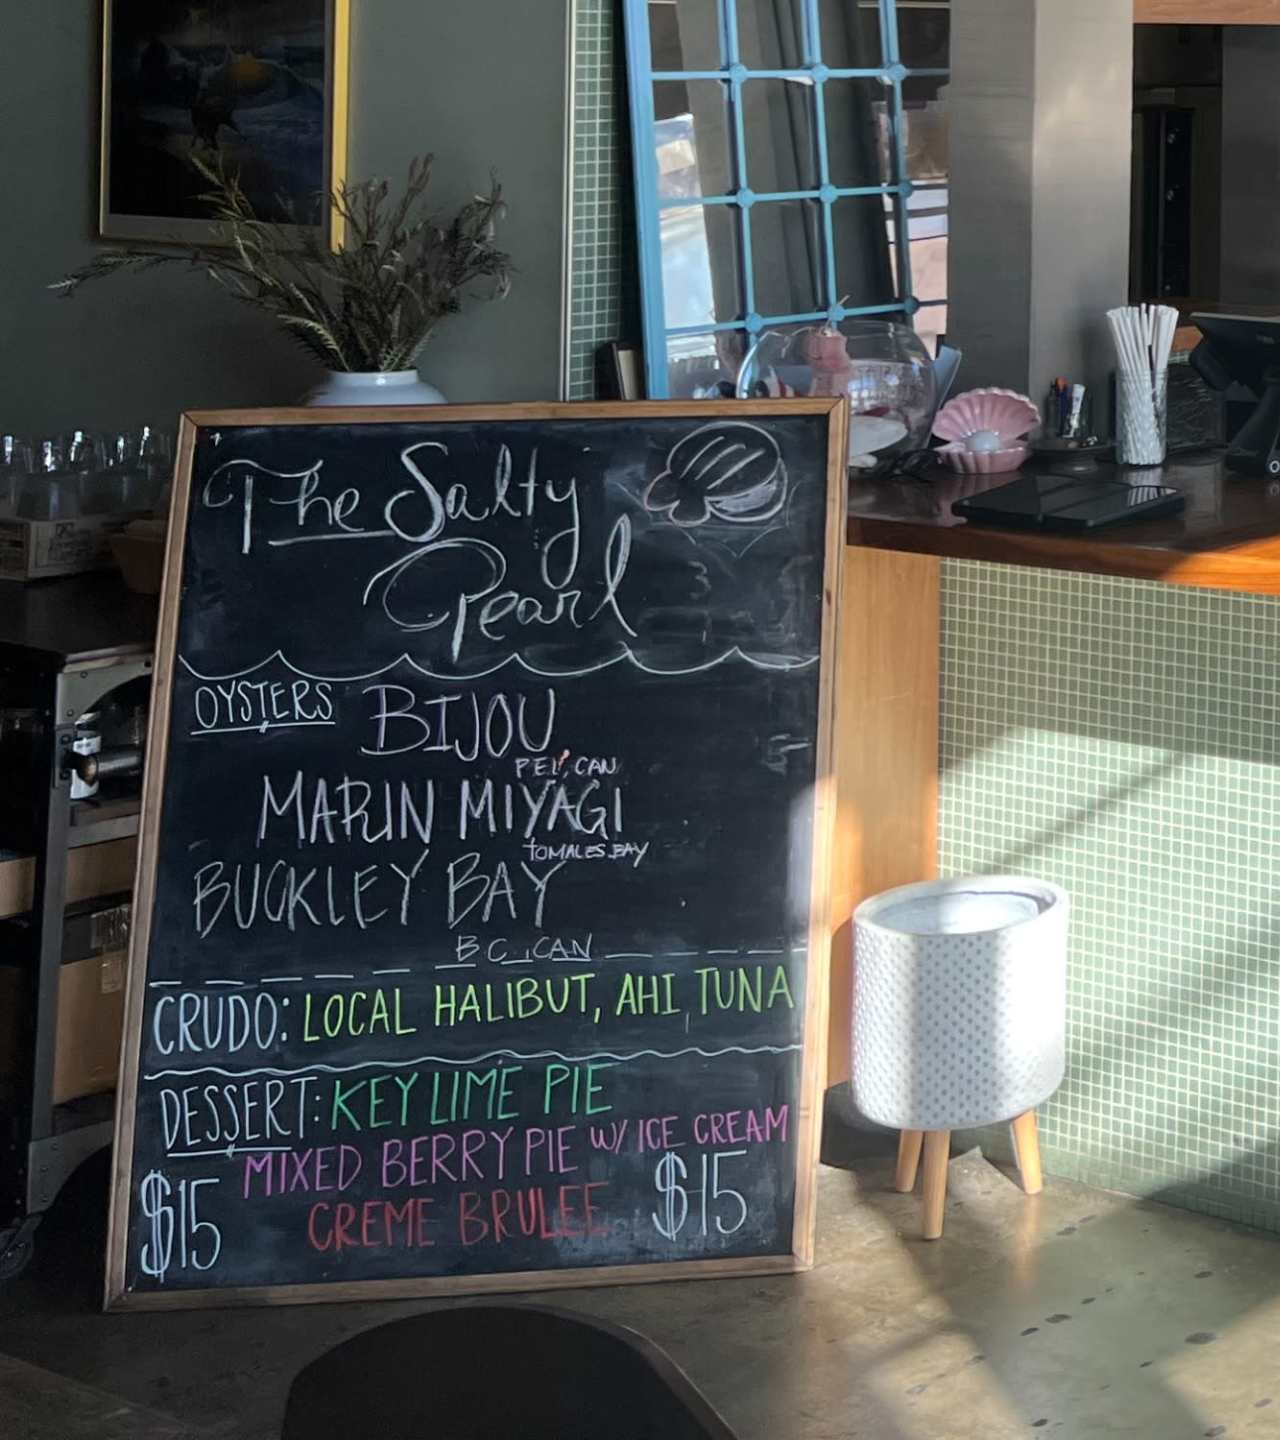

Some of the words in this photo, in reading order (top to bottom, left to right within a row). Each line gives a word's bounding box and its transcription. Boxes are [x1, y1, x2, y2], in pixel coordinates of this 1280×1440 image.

[203, 459, 364, 553] The
[384, 441, 579, 589] Salty
[362, 513, 638, 663] Pearl
[195, 680, 335, 728] OYSTERS
[360, 684, 556, 761] BIJOU
[257, 770, 435, 845] MARIN
[460, 778, 623, 841] MIYAGI
[193, 848, 430, 938] BUCKLEY
[447, 852, 566, 929] BAY
[153, 992, 289, 1055] CRUDO:
[304, 988, 418, 1042] LOCAL
[434, 973, 601, 1027] HALIBUT,
[616, 973, 681, 1016] AHI
[695, 965, 796, 1016] TUNA
[160, 1076, 321, 1151] DESSERT:
[331, 1071, 420, 1131] KEY
[430, 1064, 523, 1126] LIME
[544, 1062, 622, 1115] PIE
[243, 1144, 363, 1199] MIXED
[382, 1125, 515, 1188] BERRY
[525, 1125, 579, 1176] PIE
[638, 1115, 687, 1152] ICE
[694, 1104, 789, 1144] CREAM
[140, 1168, 222, 1284] $15
[308, 1197, 436, 1252] CREME
[459, 1181, 614, 1246] BRULEE
[652, 1149, 747, 1242] $15
